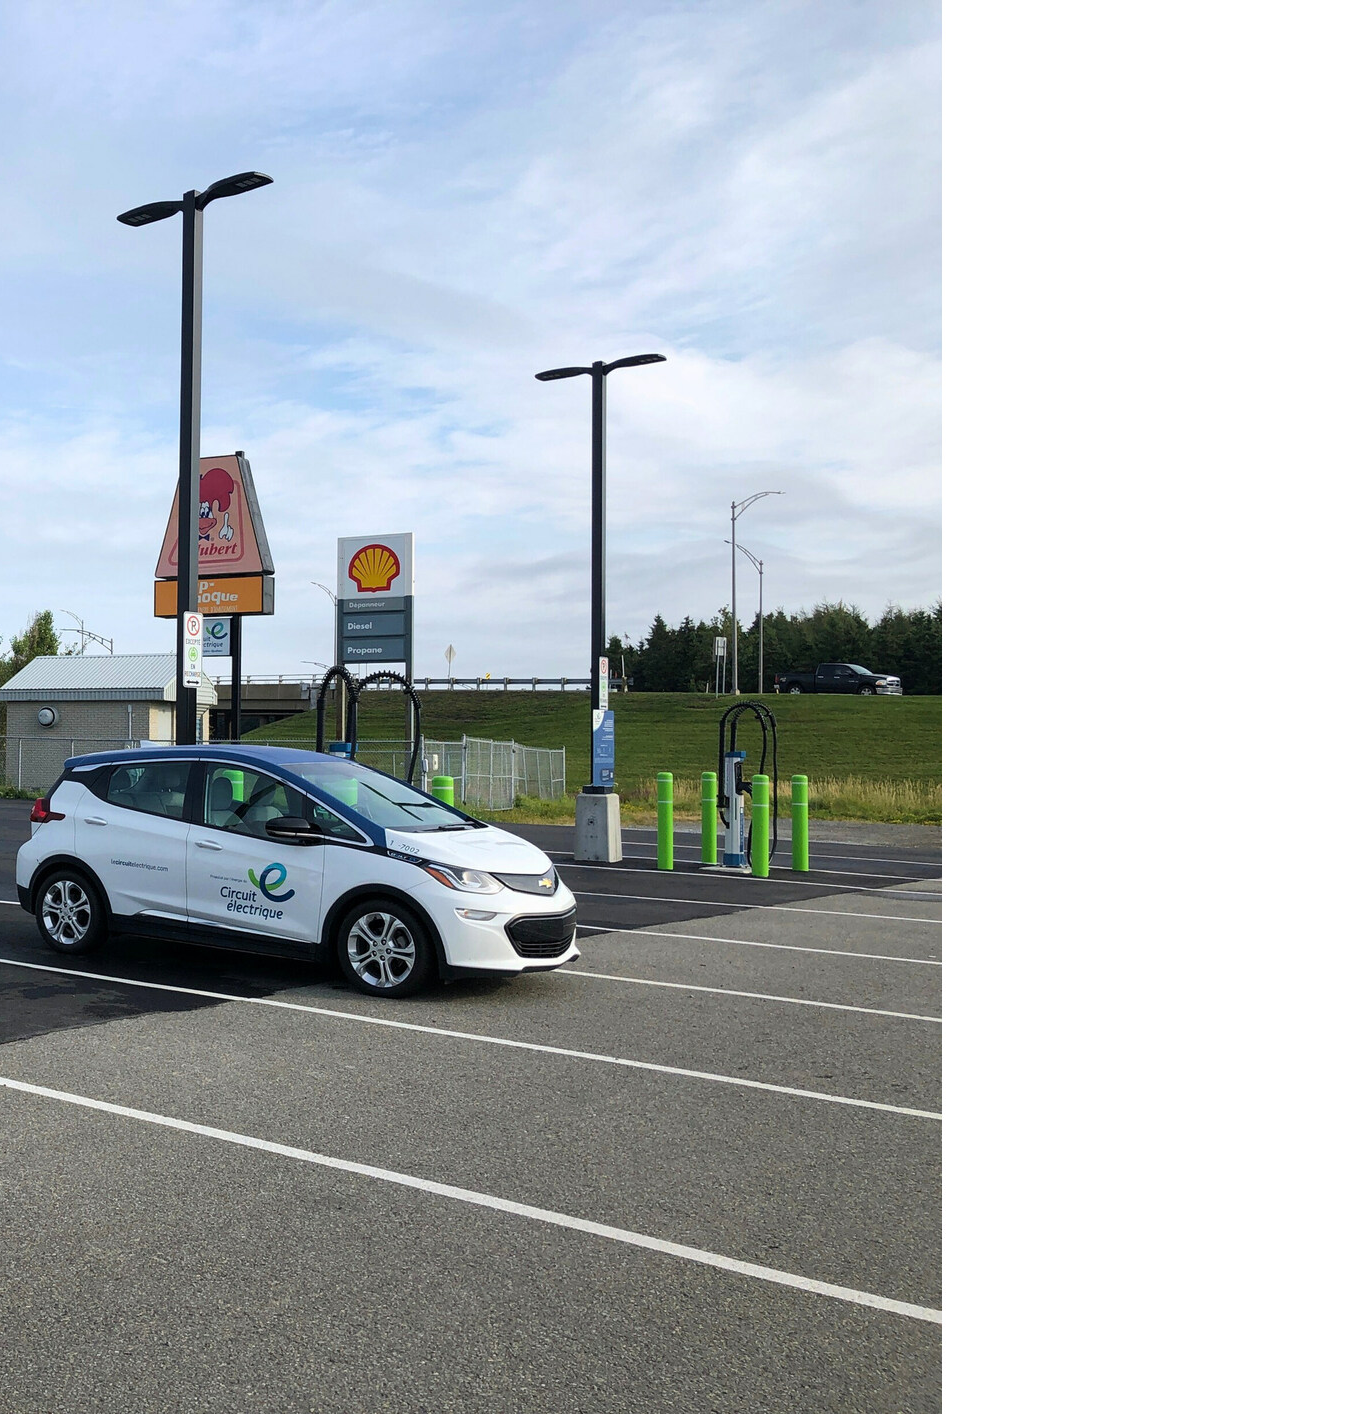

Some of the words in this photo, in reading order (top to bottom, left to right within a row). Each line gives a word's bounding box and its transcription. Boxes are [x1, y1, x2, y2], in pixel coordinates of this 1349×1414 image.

[198, 542, 237, 556] ubert
[199, 581, 215, 594] p-
[347, 621, 372, 630] Diesel
[347, 646, 383, 655] Propane
[110, 858, 169, 872] lecircuitelectrique.com
[220, 886, 257, 902] Circuit
[227, 899, 283, 920] électrique
